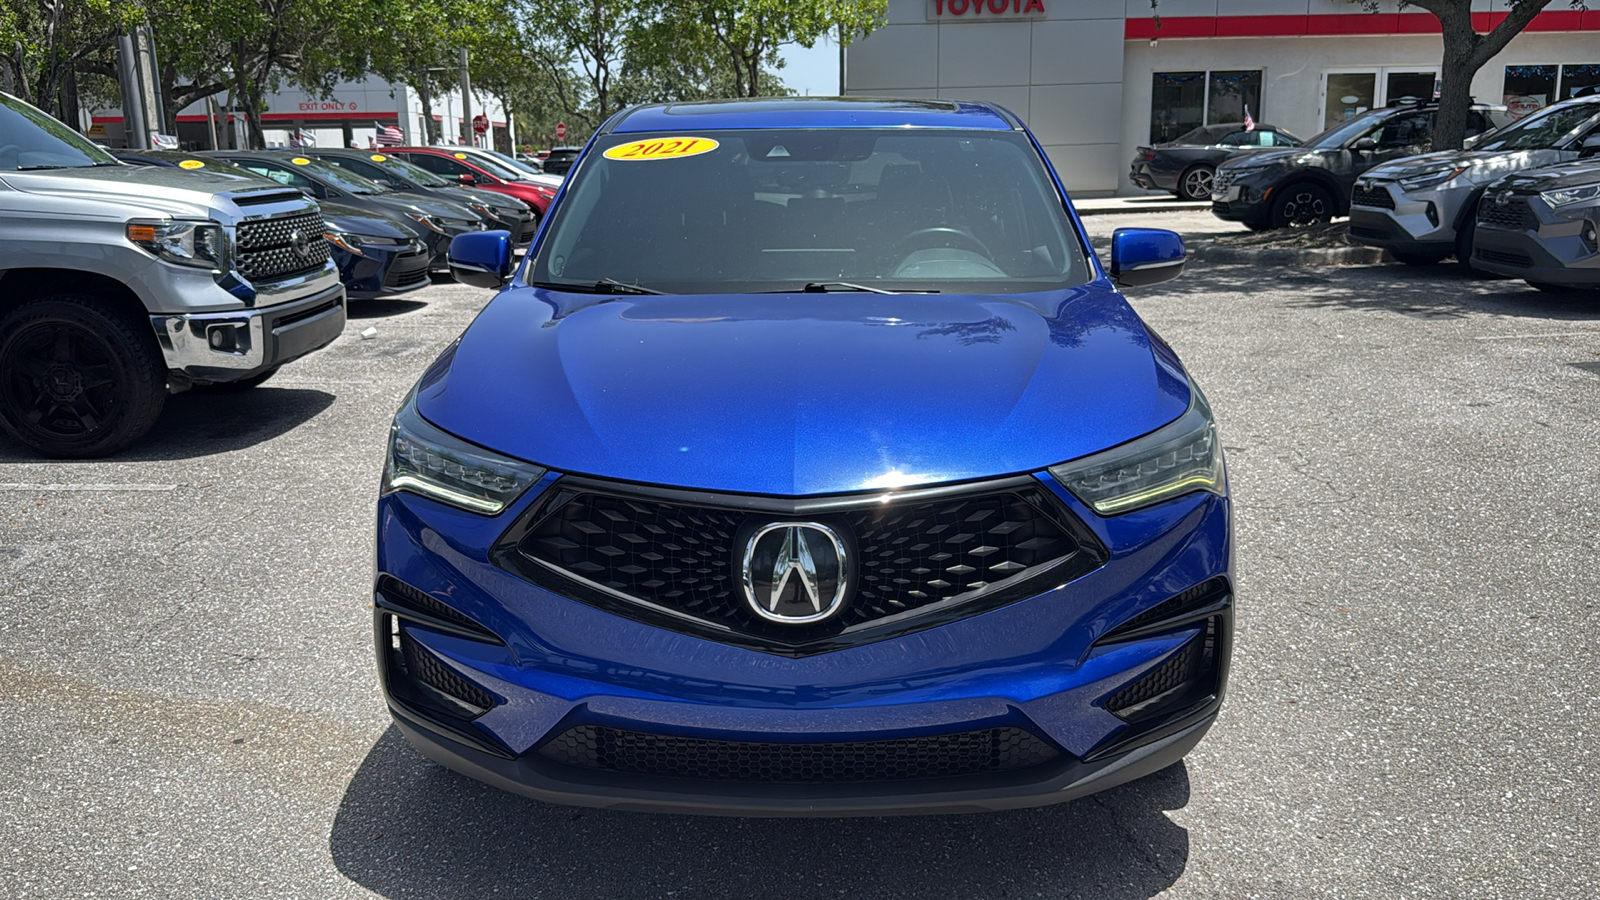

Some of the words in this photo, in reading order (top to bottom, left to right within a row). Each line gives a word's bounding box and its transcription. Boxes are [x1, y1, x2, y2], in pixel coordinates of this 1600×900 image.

[935, 0, 1045, 15] TOYOTA
[299, 102, 318, 110] EXIT
[321, 102, 345, 110] ONLY
[621, 140, 699, 157] 2021
